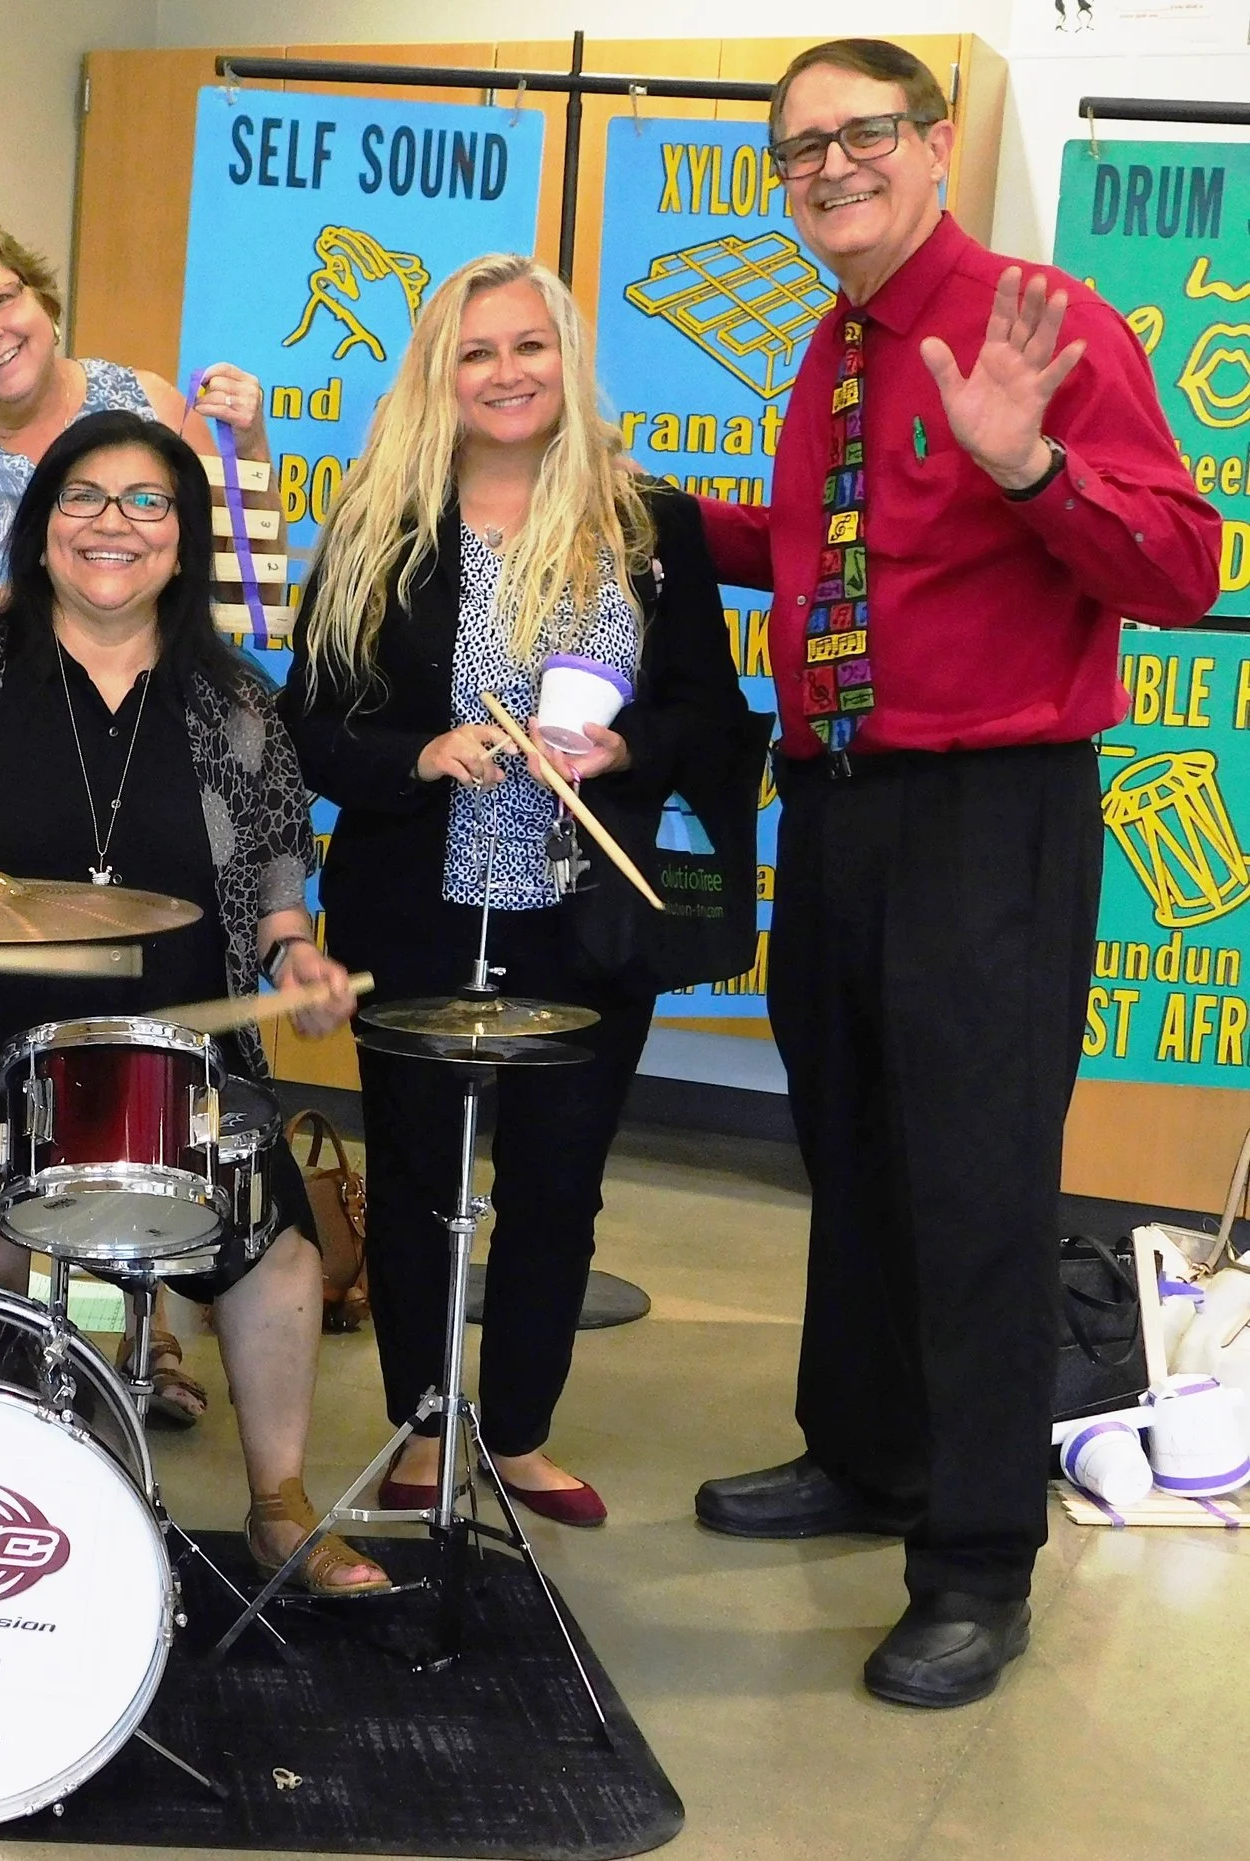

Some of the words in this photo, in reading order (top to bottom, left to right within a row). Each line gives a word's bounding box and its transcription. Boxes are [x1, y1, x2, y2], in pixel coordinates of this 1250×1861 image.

[229, 114, 336, 190] SELF
[359, 123, 509, 202] SOUND
[658, 143, 792, 218] XYLOP
[1090, 163, 1225, 239] DRUM
[271, 377, 343, 421] nd
[1093, 930, 1241, 987] undun
[1081, 986, 1140, 1058] ST
[1155, 991, 1250, 1067] AFR
